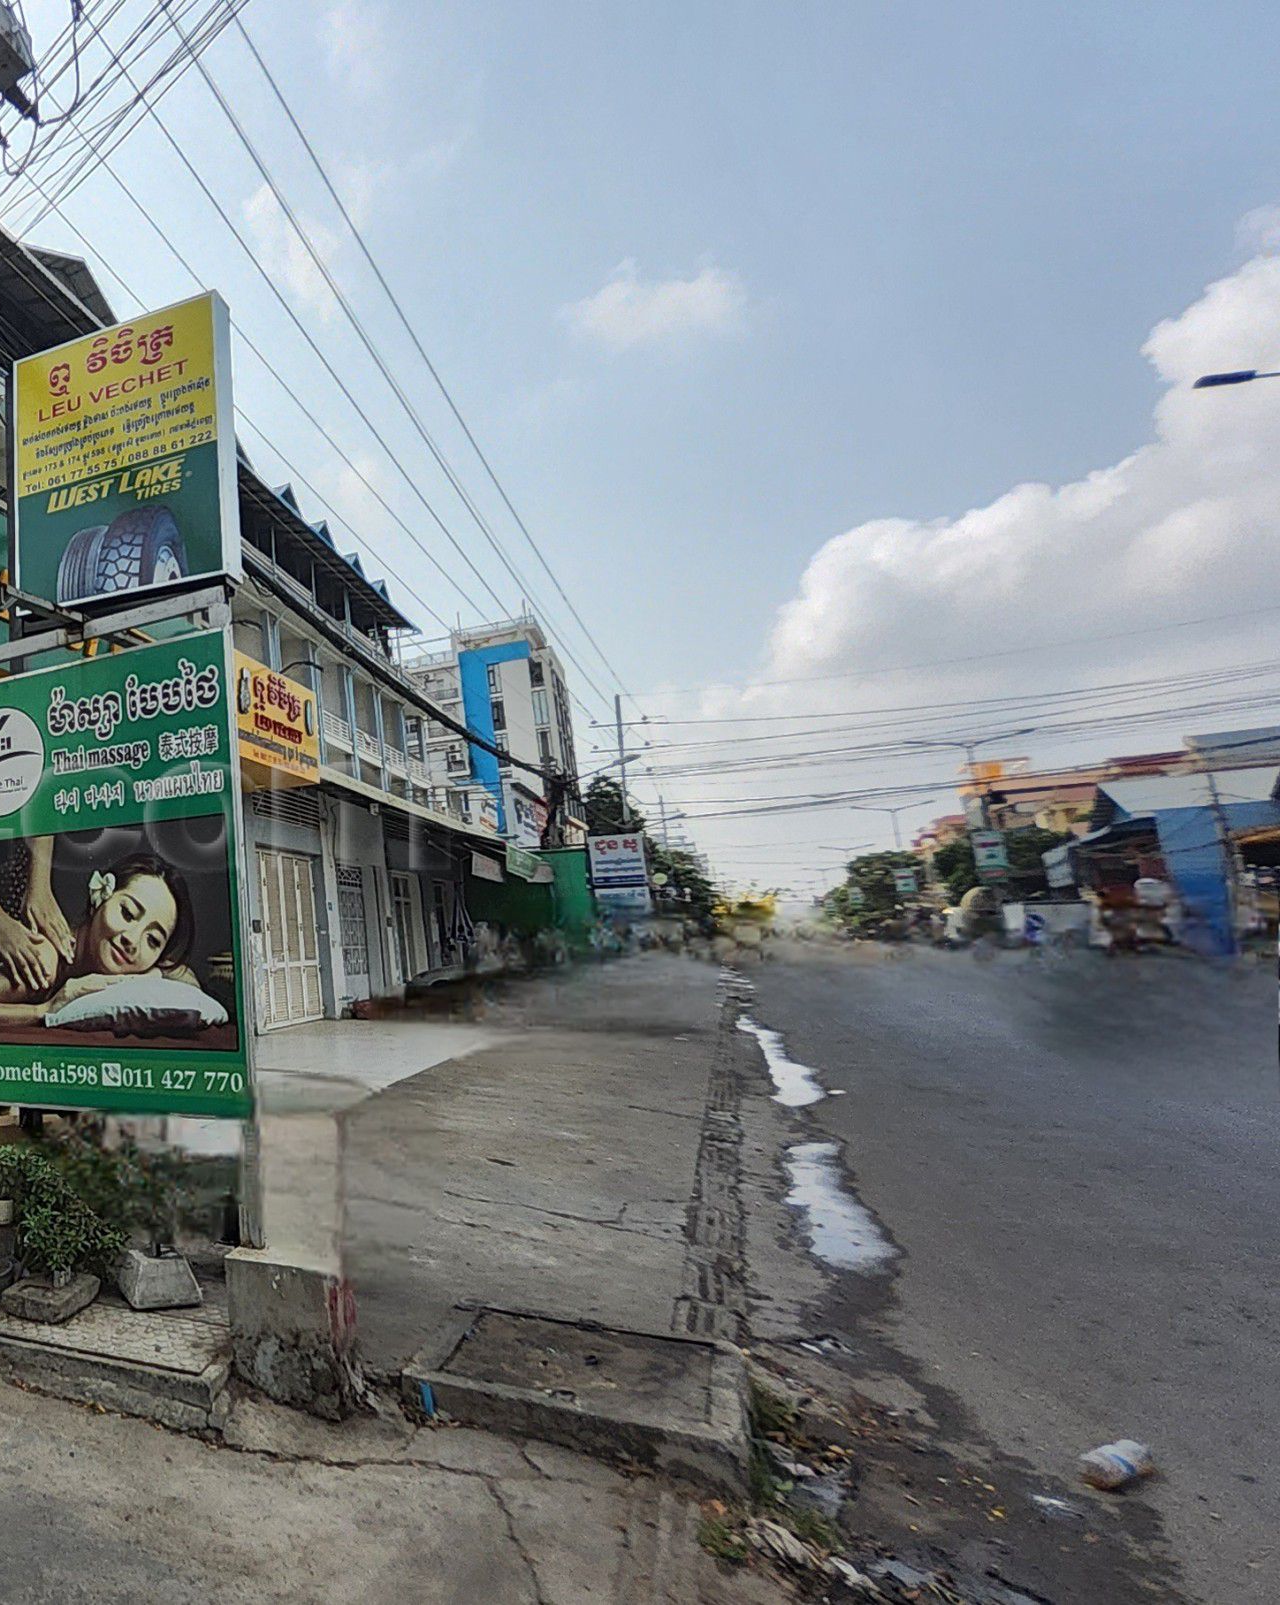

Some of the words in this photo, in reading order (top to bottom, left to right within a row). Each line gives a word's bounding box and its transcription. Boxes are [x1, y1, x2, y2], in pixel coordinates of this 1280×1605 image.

[38, 396, 81, 423] LEU
[89, 358, 189, 404] VECHET
[48, 474, 67, 487] 061
[70, 468, 83, 480] 77
[86, 463, 100, 475] 55
[104, 458, 118, 471] 75
[128, 450, 149, 463] 088
[171, 438, 184, 450] 61
[190, 430, 212, 445] 222
[47, 475, 116, 515] WEST
[119, 457, 186, 494] LAKE
[136, 479, 182, 501] TIRES
[126, 659, 219, 719] បែបថៃ
[52, 745, 85, 773] Thai
[88, 741, 150, 767] massage
[159, 726, 219, 759] 泰式按摩
[4, 776, 24, 789] Thai
[85, 781, 124, 810] 마사지
[134, 761, 224, 802] นวดแผนไทย
[122, 1066, 155, 1089] 011
[161, 1070, 197, 1091] 427
[203, 1071, 244, 1093] 770
